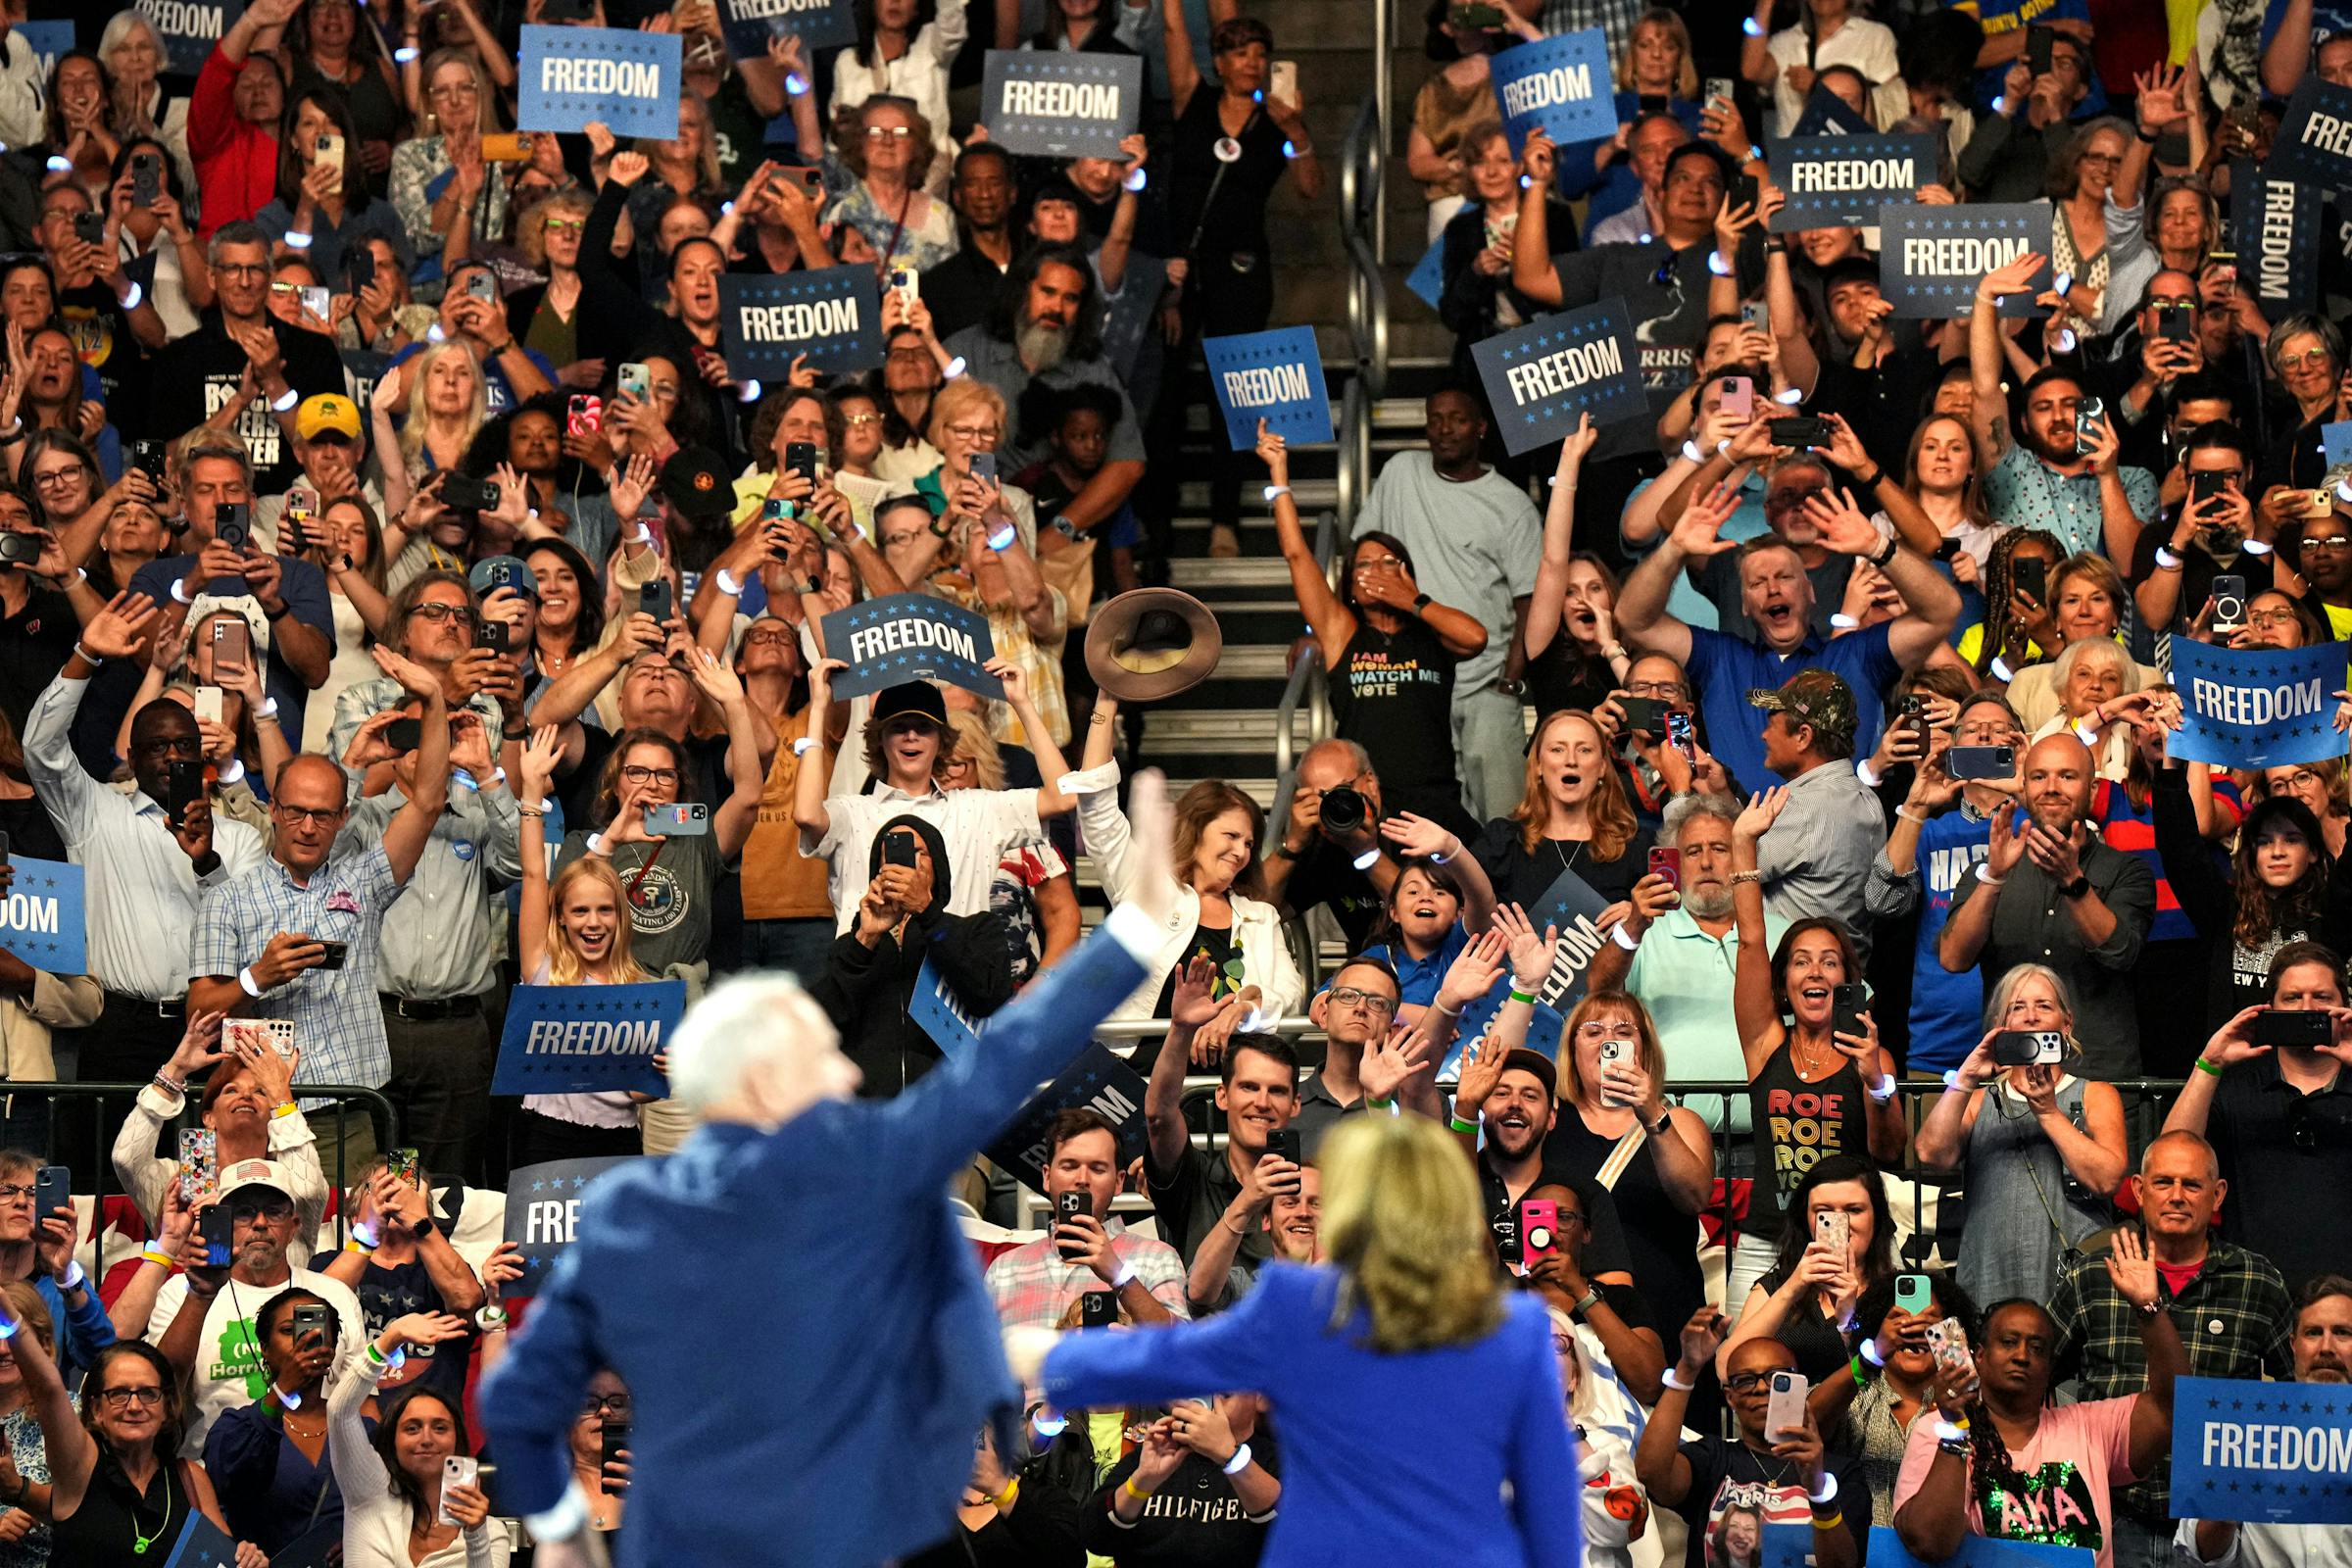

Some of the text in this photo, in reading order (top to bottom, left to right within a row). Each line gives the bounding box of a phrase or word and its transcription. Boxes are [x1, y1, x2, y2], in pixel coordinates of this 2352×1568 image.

[541, 57, 660, 99] FREEDOM
[1502, 63, 1592, 120] FREEDOM
[1003, 79, 1119, 120] FREEDOM
[1791, 158, 1914, 193] FREEDOM
[2259, 179, 2295, 299] FREEDOM
[740, 296, 859, 341] FREEDOM
[1505, 335, 1624, 407] FREEDOM
[1640, 348, 1692, 368] RRIS
[1223, 363, 1311, 408] FREEDOM
[244, 437, 280, 464] TER
[850, 618, 977, 663] FREEDOM
[1352, 651, 1387, 662] I AM
[1349, 668, 1441, 684] WATCH ME
[1350, 659, 1417, 672] WOMAN
[1352, 683, 1397, 698] VOTE
[2193, 677, 2322, 726] FREEDOM
[630, 909, 663, 926] RATING
[2234, 973, 2253, 986] EW
[525, 1019, 661, 1055] FREEDOM
[1768, 1089, 1843, 1118] ROE
[1769, 1117, 1842, 1147] ROE
[526, 1200, 581, 1244] FRE
[2202, 1421, 2352, 1473] FREEDOM
[1144, 1494, 1249, 1523] HILFIGE
[2000, 1486, 2088, 1535] AKA
